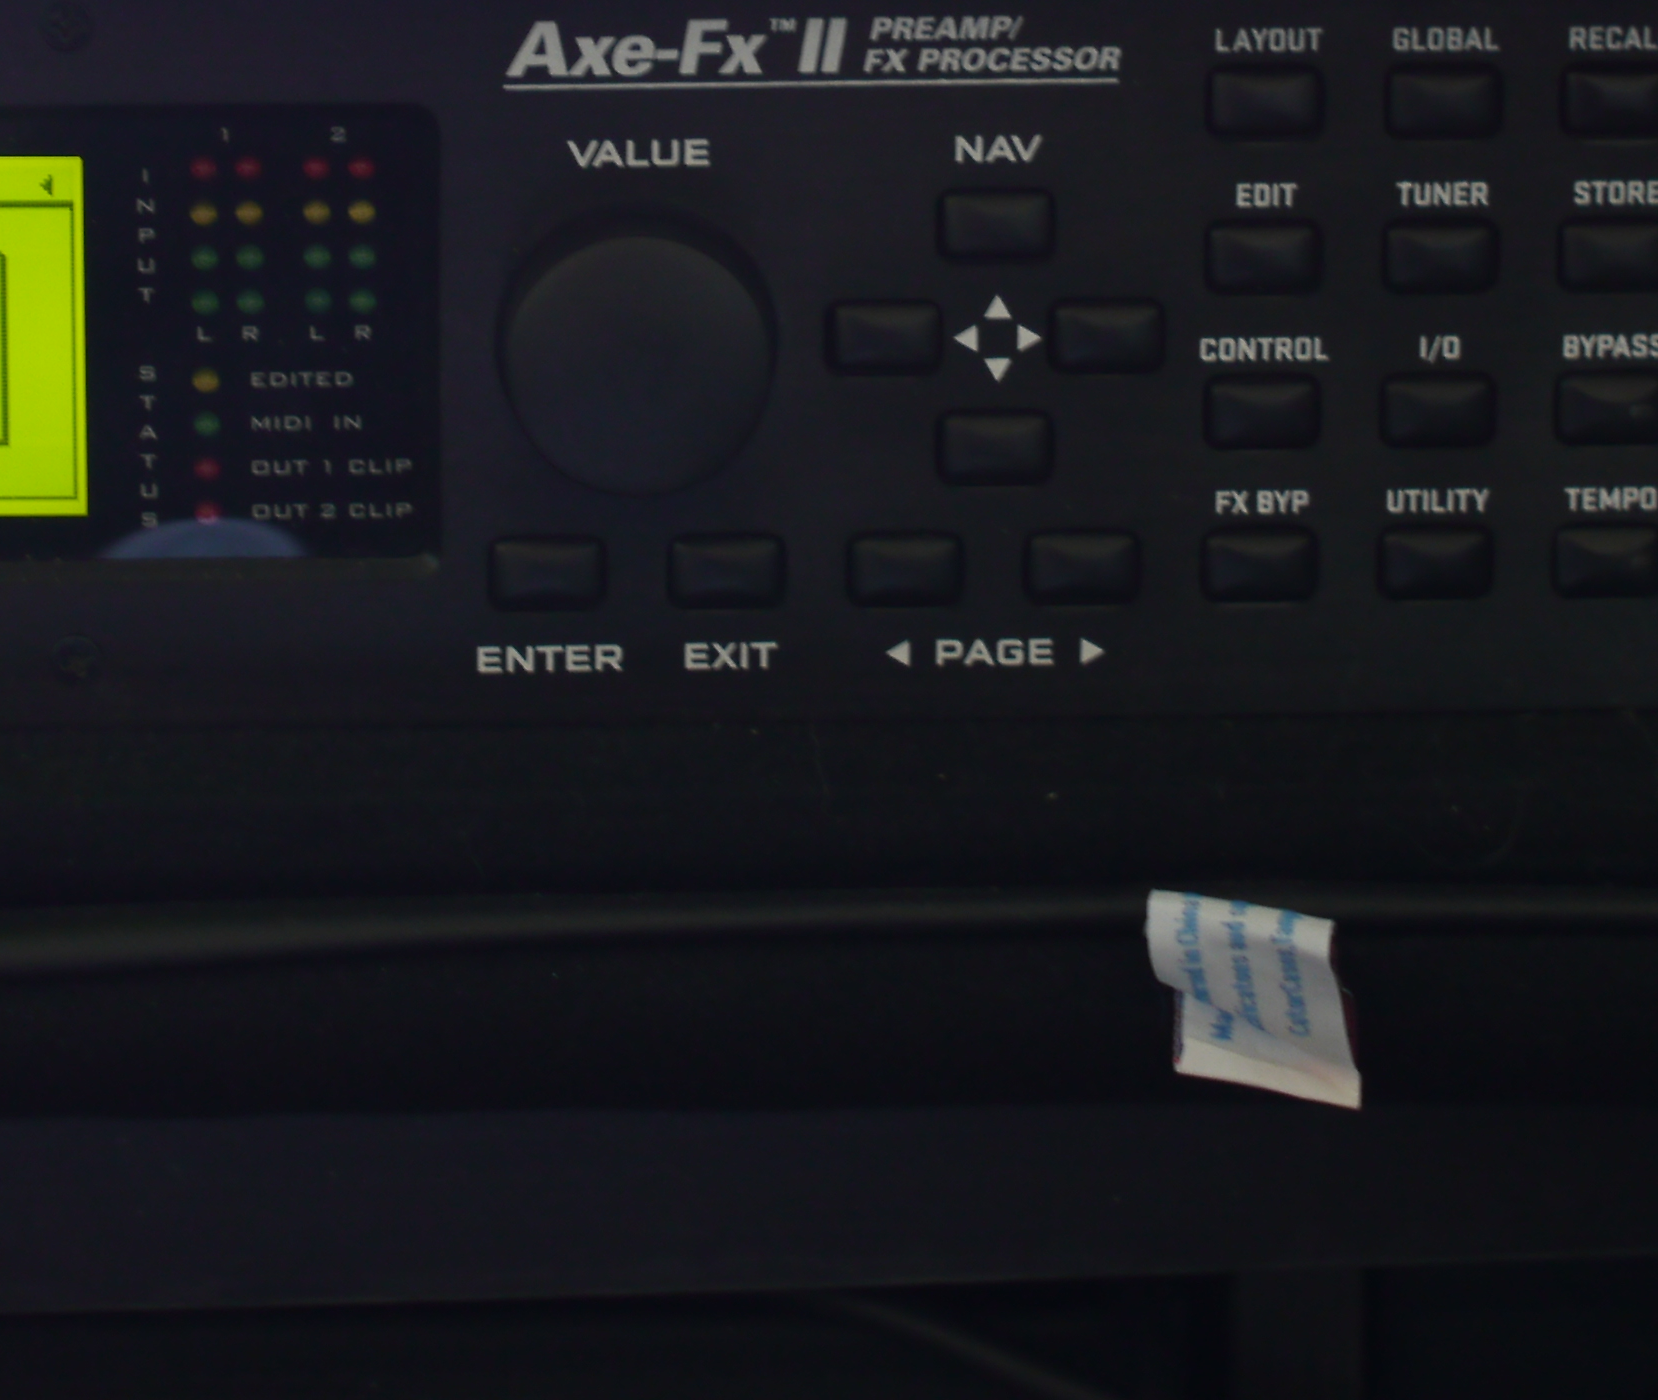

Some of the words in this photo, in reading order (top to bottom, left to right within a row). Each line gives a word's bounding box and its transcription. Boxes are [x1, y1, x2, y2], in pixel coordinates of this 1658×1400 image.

[870, 15, 1022, 41] PREAMP/
[1215, 27, 1322, 53] LAYOUT
[1392, 26, 1499, 51] GLOBAL
[799, 18, 846, 73] II
[863, 48, 908, 73] FX
[918, 46, 1121, 72] PROCESSOR
[221, 126, 230, 144] 1
[330, 126, 346, 144] 2
[567, 138, 710, 168] VALUE
[955, 134, 1042, 163] NAV
[1236, 182, 1297, 208] EDIT
[1396, 181, 1489, 206] TUNER
[196, 325, 211, 342] L
[242, 325, 259, 341] R
[309, 325, 324, 342] L
[354, 324, 372, 340] R
[1200, 337, 1329, 362] CONTROL
[1419, 335, 1461, 362] I/O
[250, 371, 353, 388] EDITED
[251, 415, 311, 432] MIDI
[333, 415, 362, 430] IN
[251, 458, 307, 476] OUT
[323, 459, 332, 475] 1
[348, 457, 412, 475] CLIP
[1215, 490, 1249, 514] FX
[1256, 489, 1309, 514] BYP
[1386, 488, 1489, 514] UTILITY
[1564, 486, 1658, 511] TEMPO
[251, 502, 309, 521] OUT
[320, 502, 336, 519] 2
[348, 502, 413, 520] CLIP
[477, 644, 623, 674] ENTER
[684, 641, 778, 670] EXIT
[935, 638, 1054, 666] PAGE
